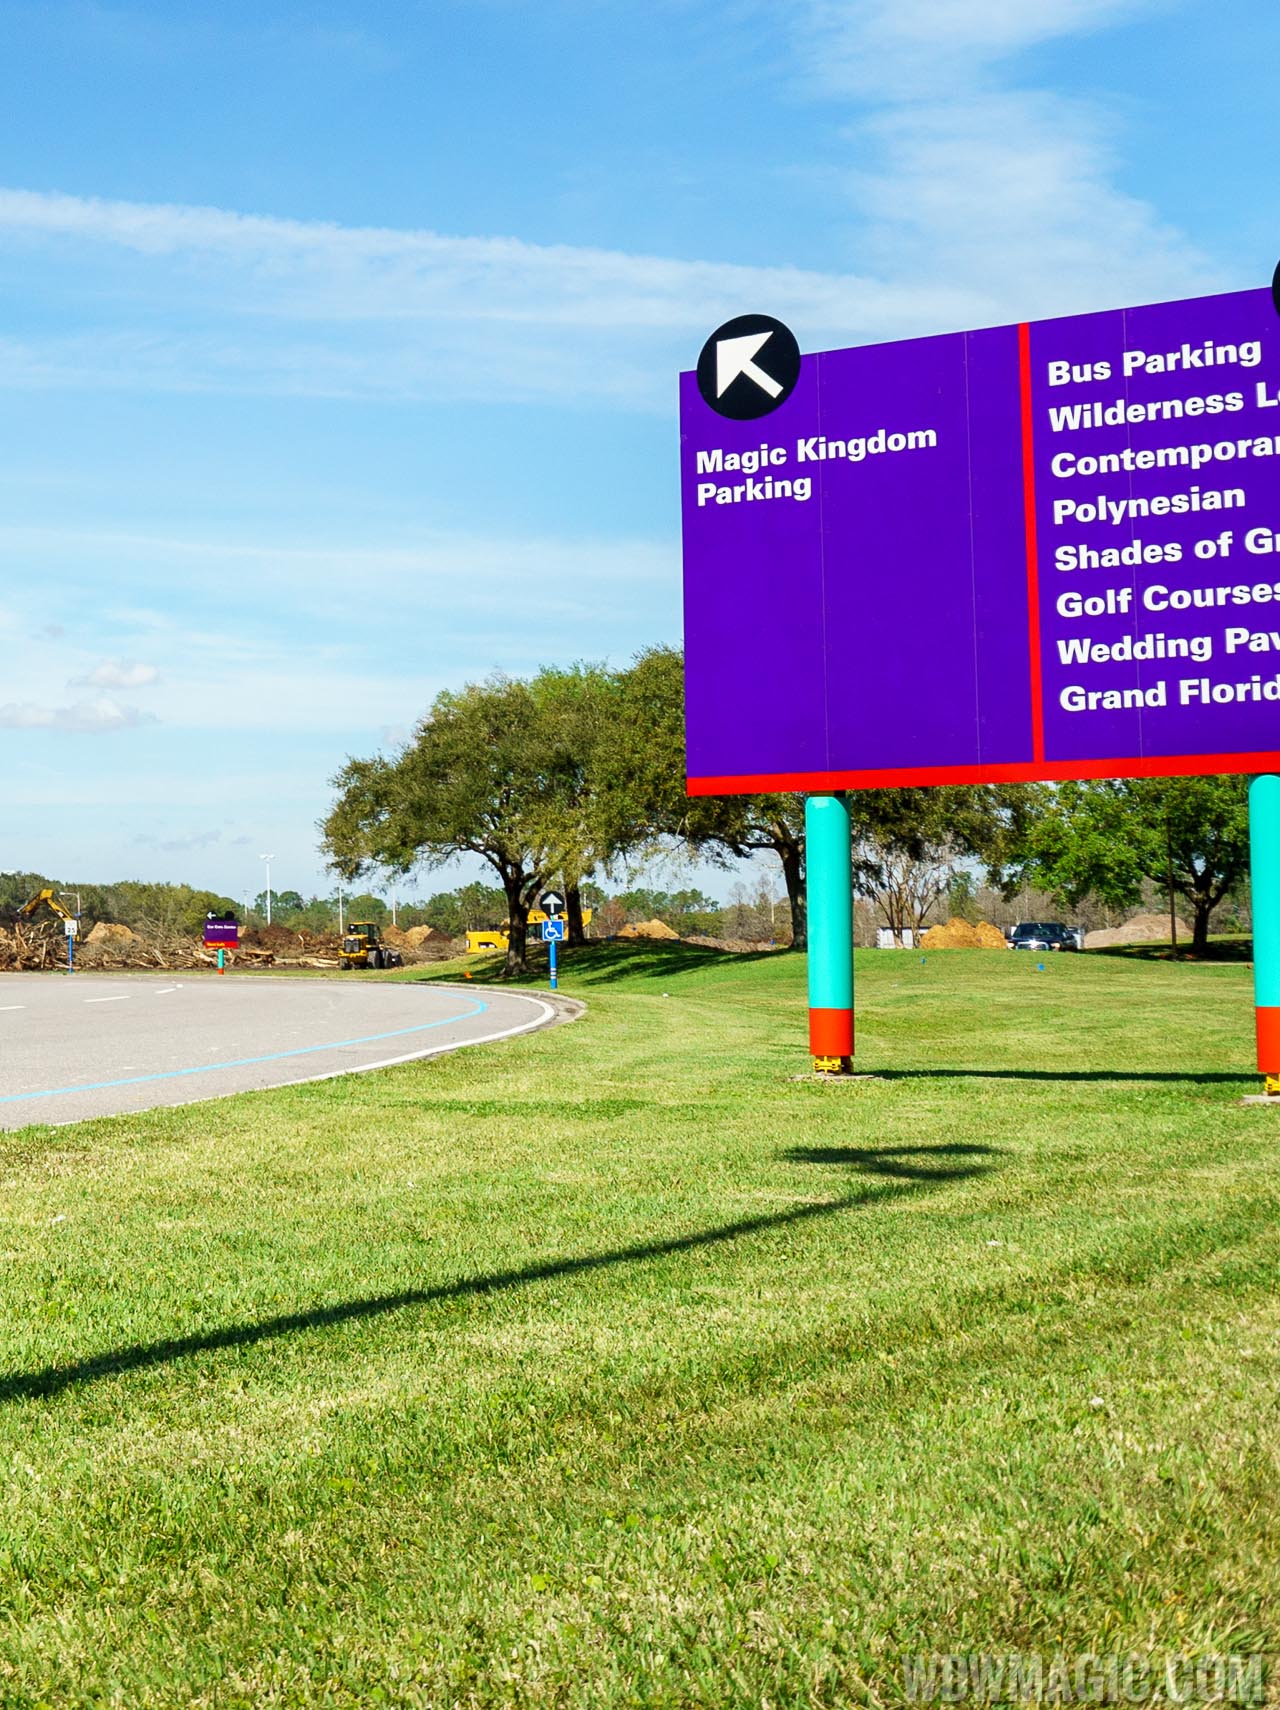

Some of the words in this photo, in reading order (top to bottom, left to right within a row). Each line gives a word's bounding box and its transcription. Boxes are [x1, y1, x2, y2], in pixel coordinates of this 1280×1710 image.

[1048, 360, 1112, 387] Bus
[1122, 340, 1262, 377] Parking
[1048, 392, 1245, 433] Wilderness
[1256, 381, 1280, 408] L
[696, 443, 787, 475] Magic
[797, 429, 937, 463] Kingdom
[697, 475, 812, 507] Parking
[1053, 485, 1246, 526] Polynesian
[1054, 539, 1183, 572] Shades
[1194, 530, 1234, 559] of
[1056, 586, 1133, 618] Golf
[1056, 633, 1213, 665] Wedding
[1060, 680, 1167, 712] Grand
[1180, 673, 1280, 705] Florid
